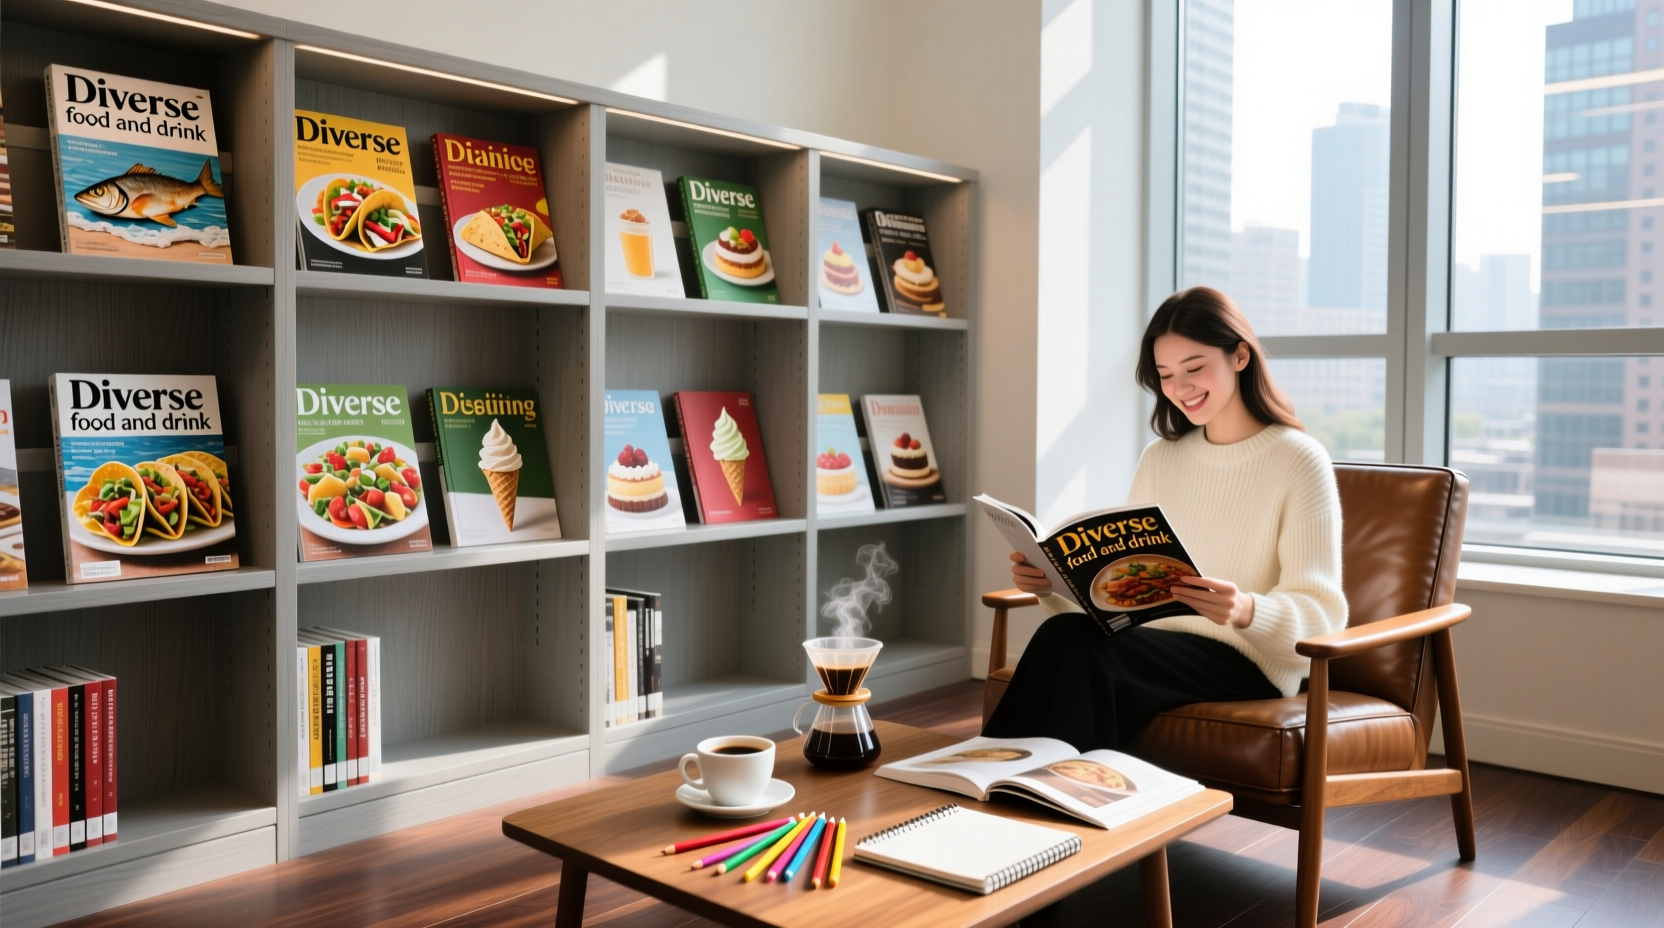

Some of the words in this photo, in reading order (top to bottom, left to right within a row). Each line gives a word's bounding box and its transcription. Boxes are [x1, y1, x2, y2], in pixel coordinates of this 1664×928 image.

[64, 73, 200, 120] Diverse
[66, 106, 110, 128] food
[116, 117, 151, 134] and
[157, 120, 206, 142] drink
[295, 115, 401, 155] Diverse
[688, 180, 755, 208] Diverse
[69, 379, 203, 410] Diverse
[296, 387, 401, 415] Diverse
[605, 394, 655, 414] iverse
[70, 412, 115, 431] food
[121, 413, 156, 430] and
[162, 412, 211, 430] drink
[1055, 516, 1159, 557] Diverse
[1128, 530, 1172, 549] drink
